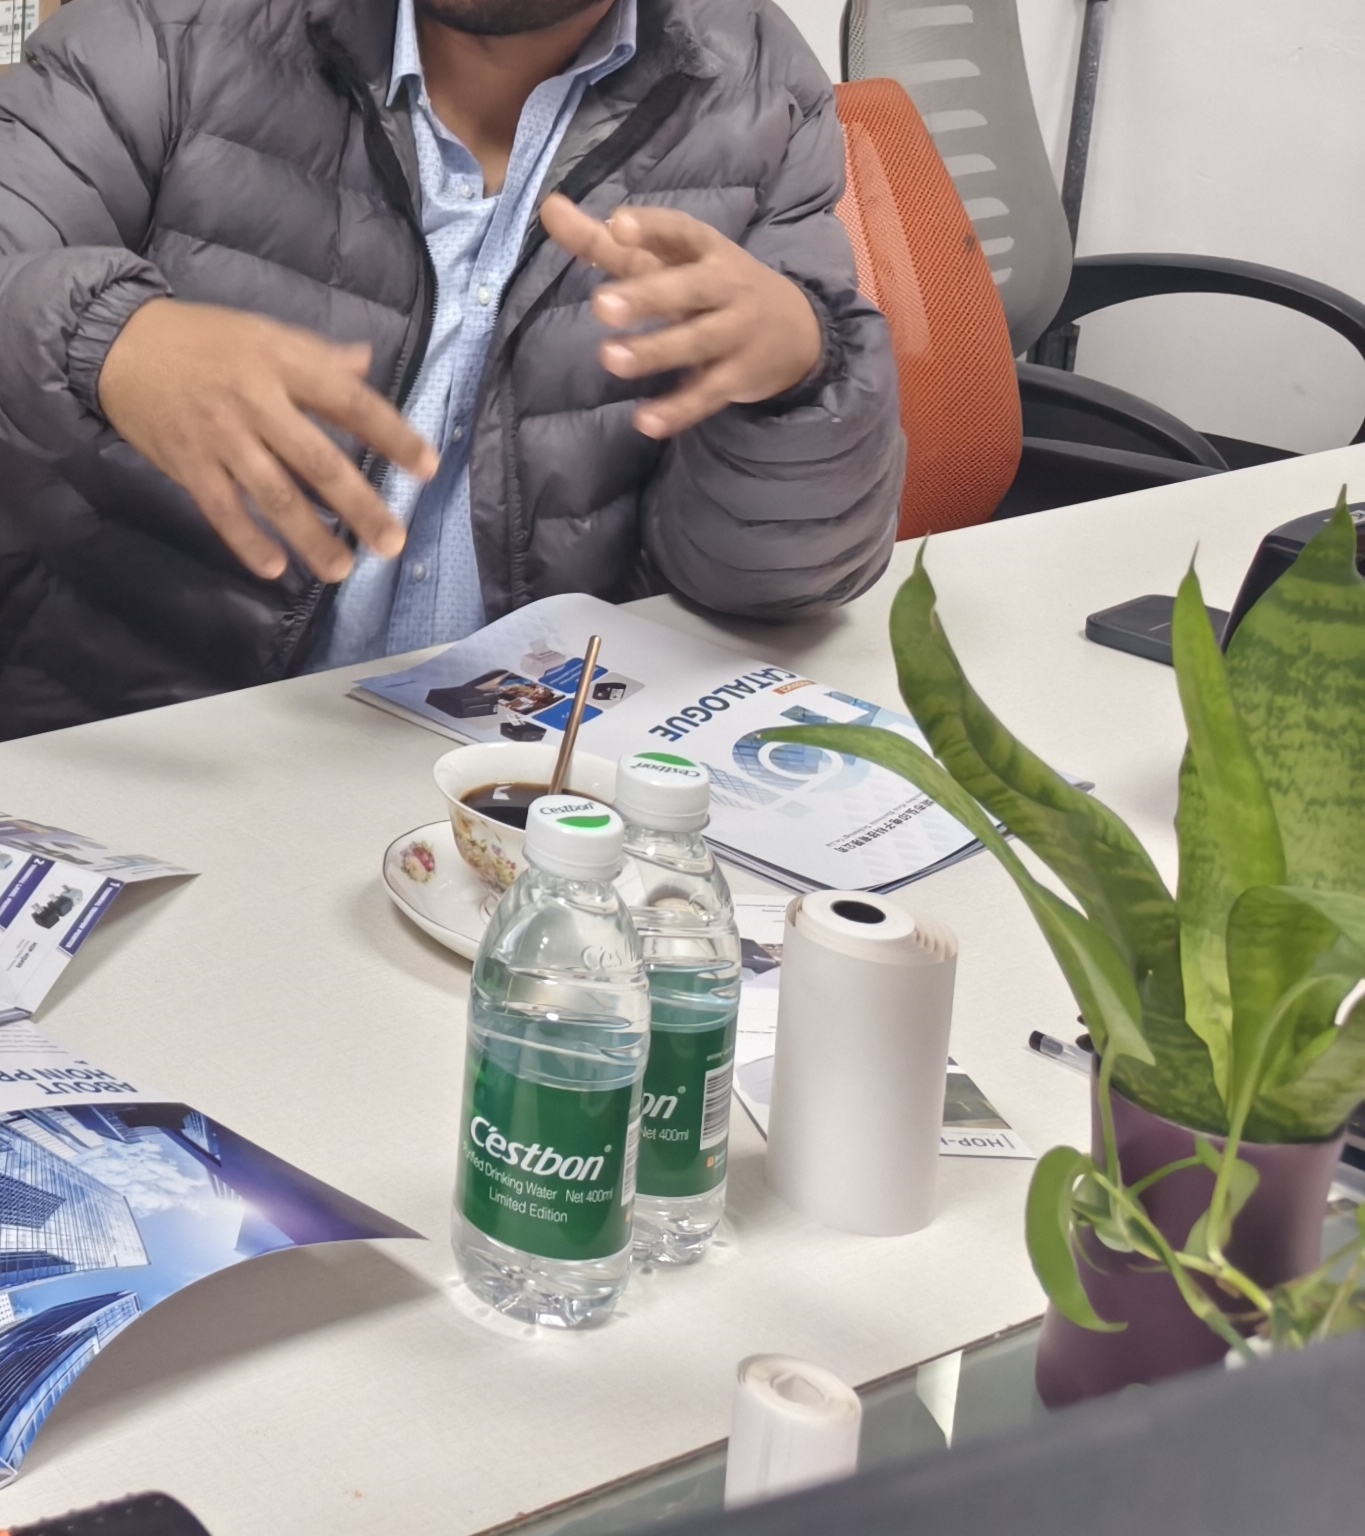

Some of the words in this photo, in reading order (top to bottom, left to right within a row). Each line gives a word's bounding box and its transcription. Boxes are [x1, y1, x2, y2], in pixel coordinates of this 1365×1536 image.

[647, 668, 801, 744] CATALOGUE
[31, 1067, 119, 1081] HOIN
[35, 1080, 140, 1096] ABOUT
[658, 1125, 690, 1142] 400ml
[484, 1163, 524, 1196] Drinking
[525, 1178, 558, 1202] Water
[565, 1188, 584, 1203] Net
[585, 1186, 614, 1203] 400ml
[488, 1187, 529, 1215] Limited
[530, 1200, 569, 1224] Edition
